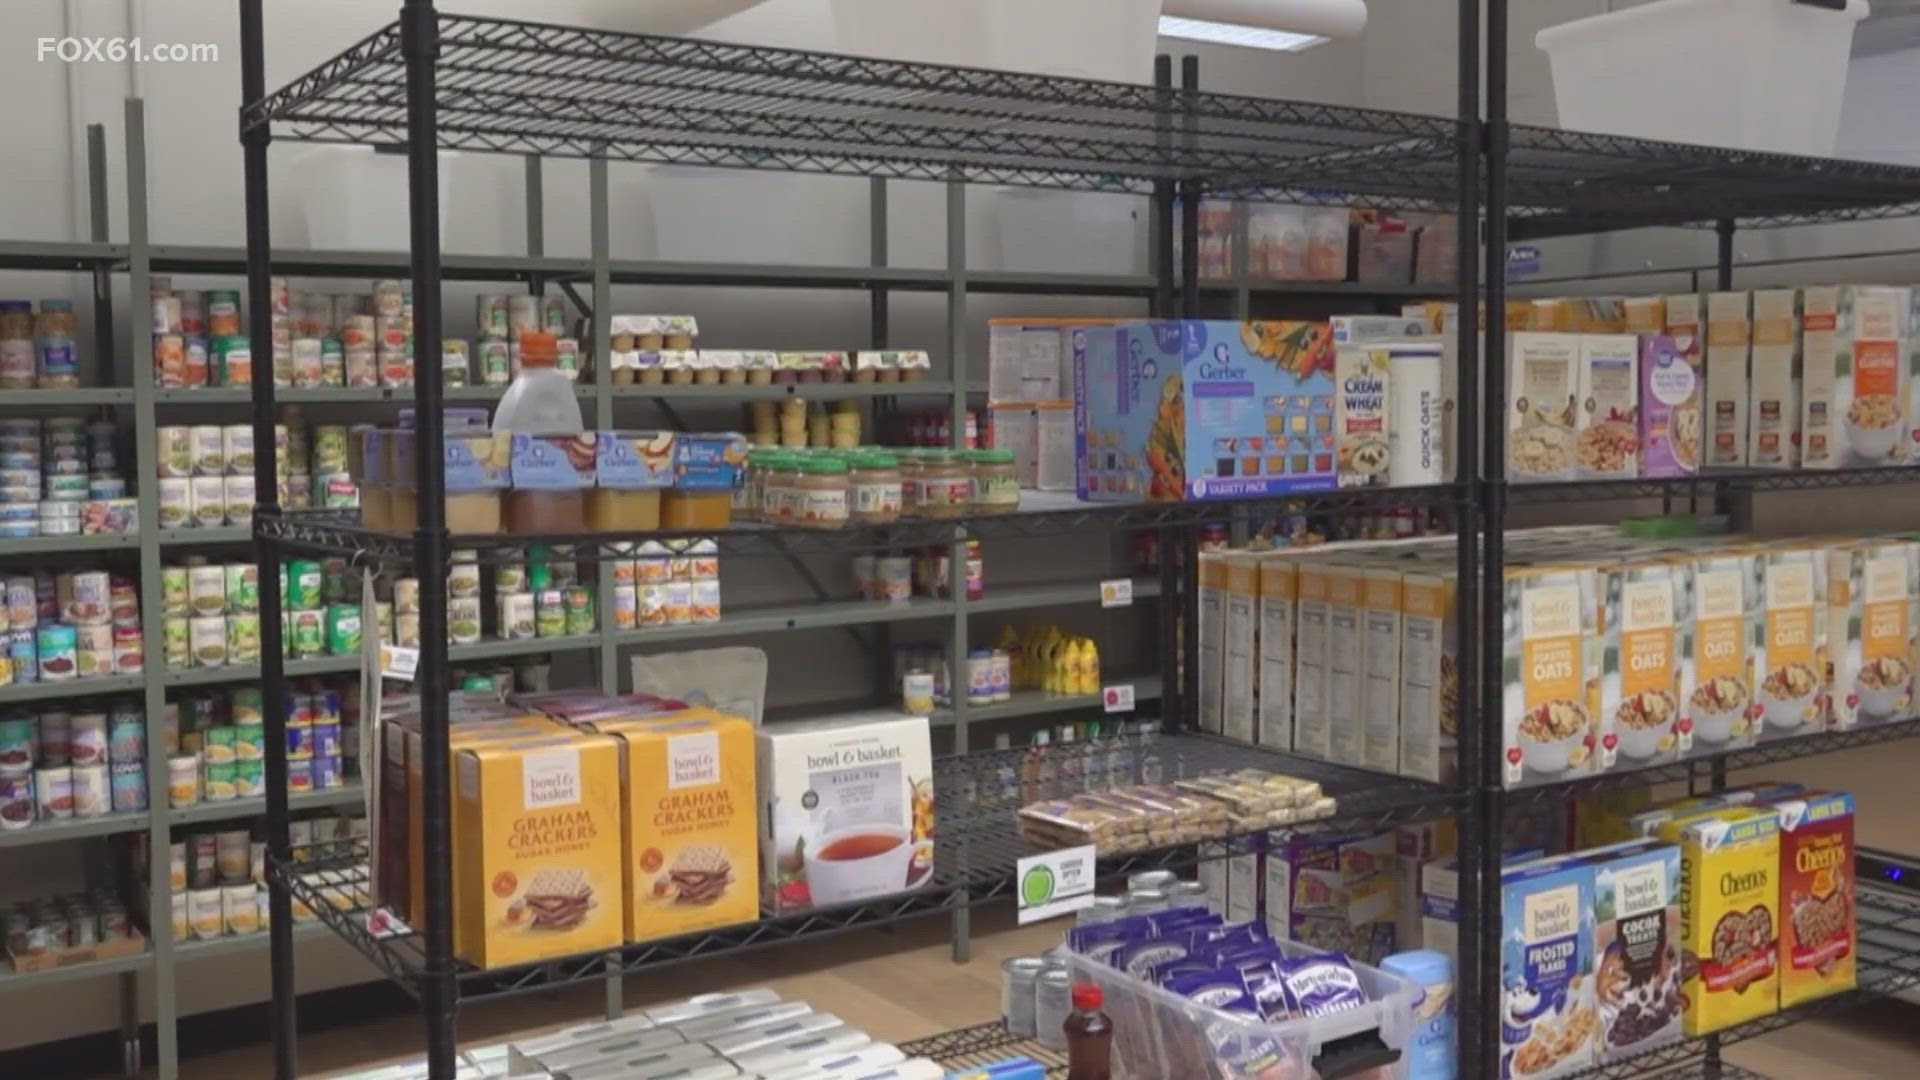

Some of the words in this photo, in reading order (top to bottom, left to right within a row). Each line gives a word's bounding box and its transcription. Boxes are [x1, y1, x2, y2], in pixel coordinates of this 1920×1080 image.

[1200, 361, 1247, 380] Gerber
[1344, 377, 1383, 394] CREAM
[1345, 395, 1383, 411] WHEAT
[1420, 390, 1431, 426] OATS
[1420, 428, 1431, 469] QUICK
[1208, 484, 1244, 496] VARIETY
[1246, 481, 1268, 493] PACK
[1775, 629, 1806, 647] OATS
[1704, 640, 1737, 660] OATS
[1533, 661, 1573, 681] OATS
[1630, 653, 1666, 672] OATS
[674, 755, 702, 769] bowl
[808, 752, 839, 770] bowl
[857, 745, 901, 762] basket
[530, 774, 561, 790] bowl
[675, 767, 713, 782] basket
[531, 786, 573, 803] basket
[658, 789, 729, 811] GRAHAM
[513, 809, 592, 833] GRAHAM
[653, 801, 735, 828] CRACKERS
[506, 822, 598, 850] CRACKERS
[1796, 844, 1846, 873] Cheerios
[1720, 867, 1768, 897] Cheerios
[1534, 904, 1560, 922] bowl
[1622, 914, 1661, 935] COCOA
[1529, 941, 1576, 966] FROSTED
